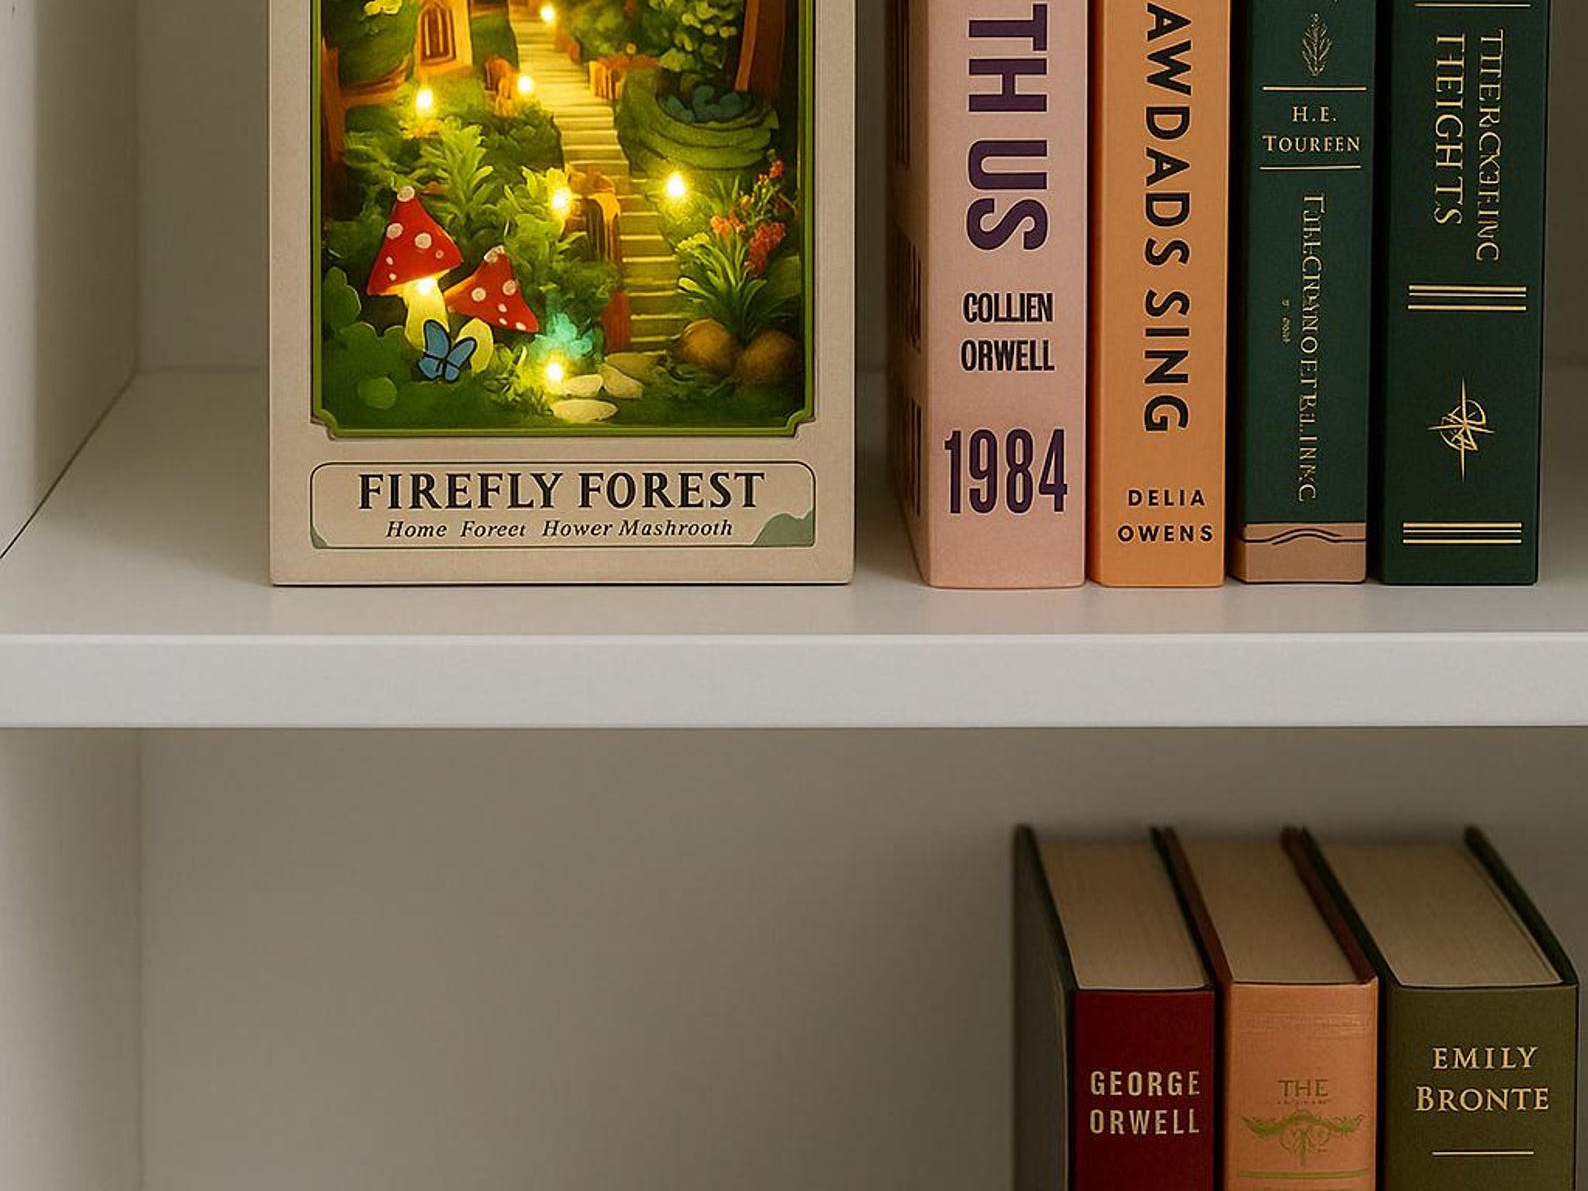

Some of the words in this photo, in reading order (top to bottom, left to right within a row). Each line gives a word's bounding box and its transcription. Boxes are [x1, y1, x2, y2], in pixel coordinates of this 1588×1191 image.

[1291, 106, 1337, 122] H.E.
[966, 139, 1049, 250] US
[961, 339, 1055, 372] ORWELL
[1143, 289, 1190, 433] SING
[944, 429, 1068, 515] 1984
[358, 472, 564, 510] FIREFLY
[577, 472, 765, 510] FOREST
[1127, 489, 1206, 507] DELIA
[385, 520, 448, 538] Home
[541, 520, 613, 537] Hower
[618, 519, 733, 537] Mashrooth
[1117, 525, 1214, 543] OWENS
[1432, 1046, 1539, 1070] EMILY
[1090, 1070, 1201, 1097] GEORGE
[1278, 1079, 1330, 1097] THE
[1415, 1086, 1551, 1113] BRONTE
[1090, 1109, 1201, 1135] ORWELL
